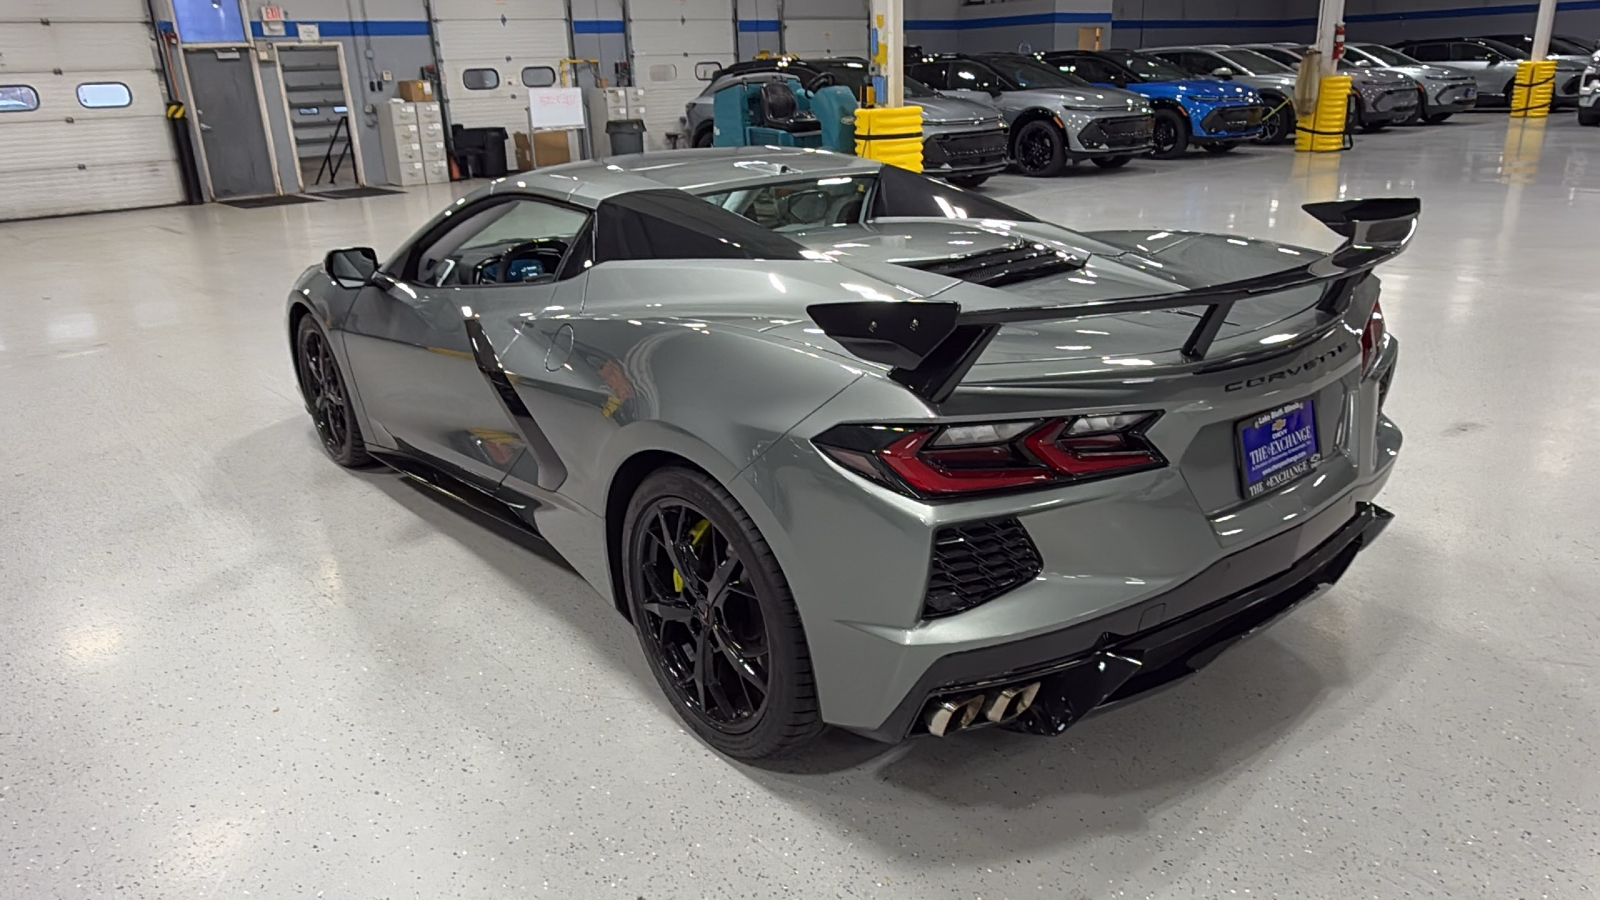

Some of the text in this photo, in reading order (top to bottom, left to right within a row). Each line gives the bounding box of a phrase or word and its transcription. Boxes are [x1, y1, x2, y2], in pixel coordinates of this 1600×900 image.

[265, 6, 281, 19] EXIT
[1224, 341, 1348, 393] CORVETTE
[1249, 445, 1269, 465] THE
[1269, 425, 1311, 456] EXCHANGE
[1249, 460, 1308, 497] THE EXCHANGE
